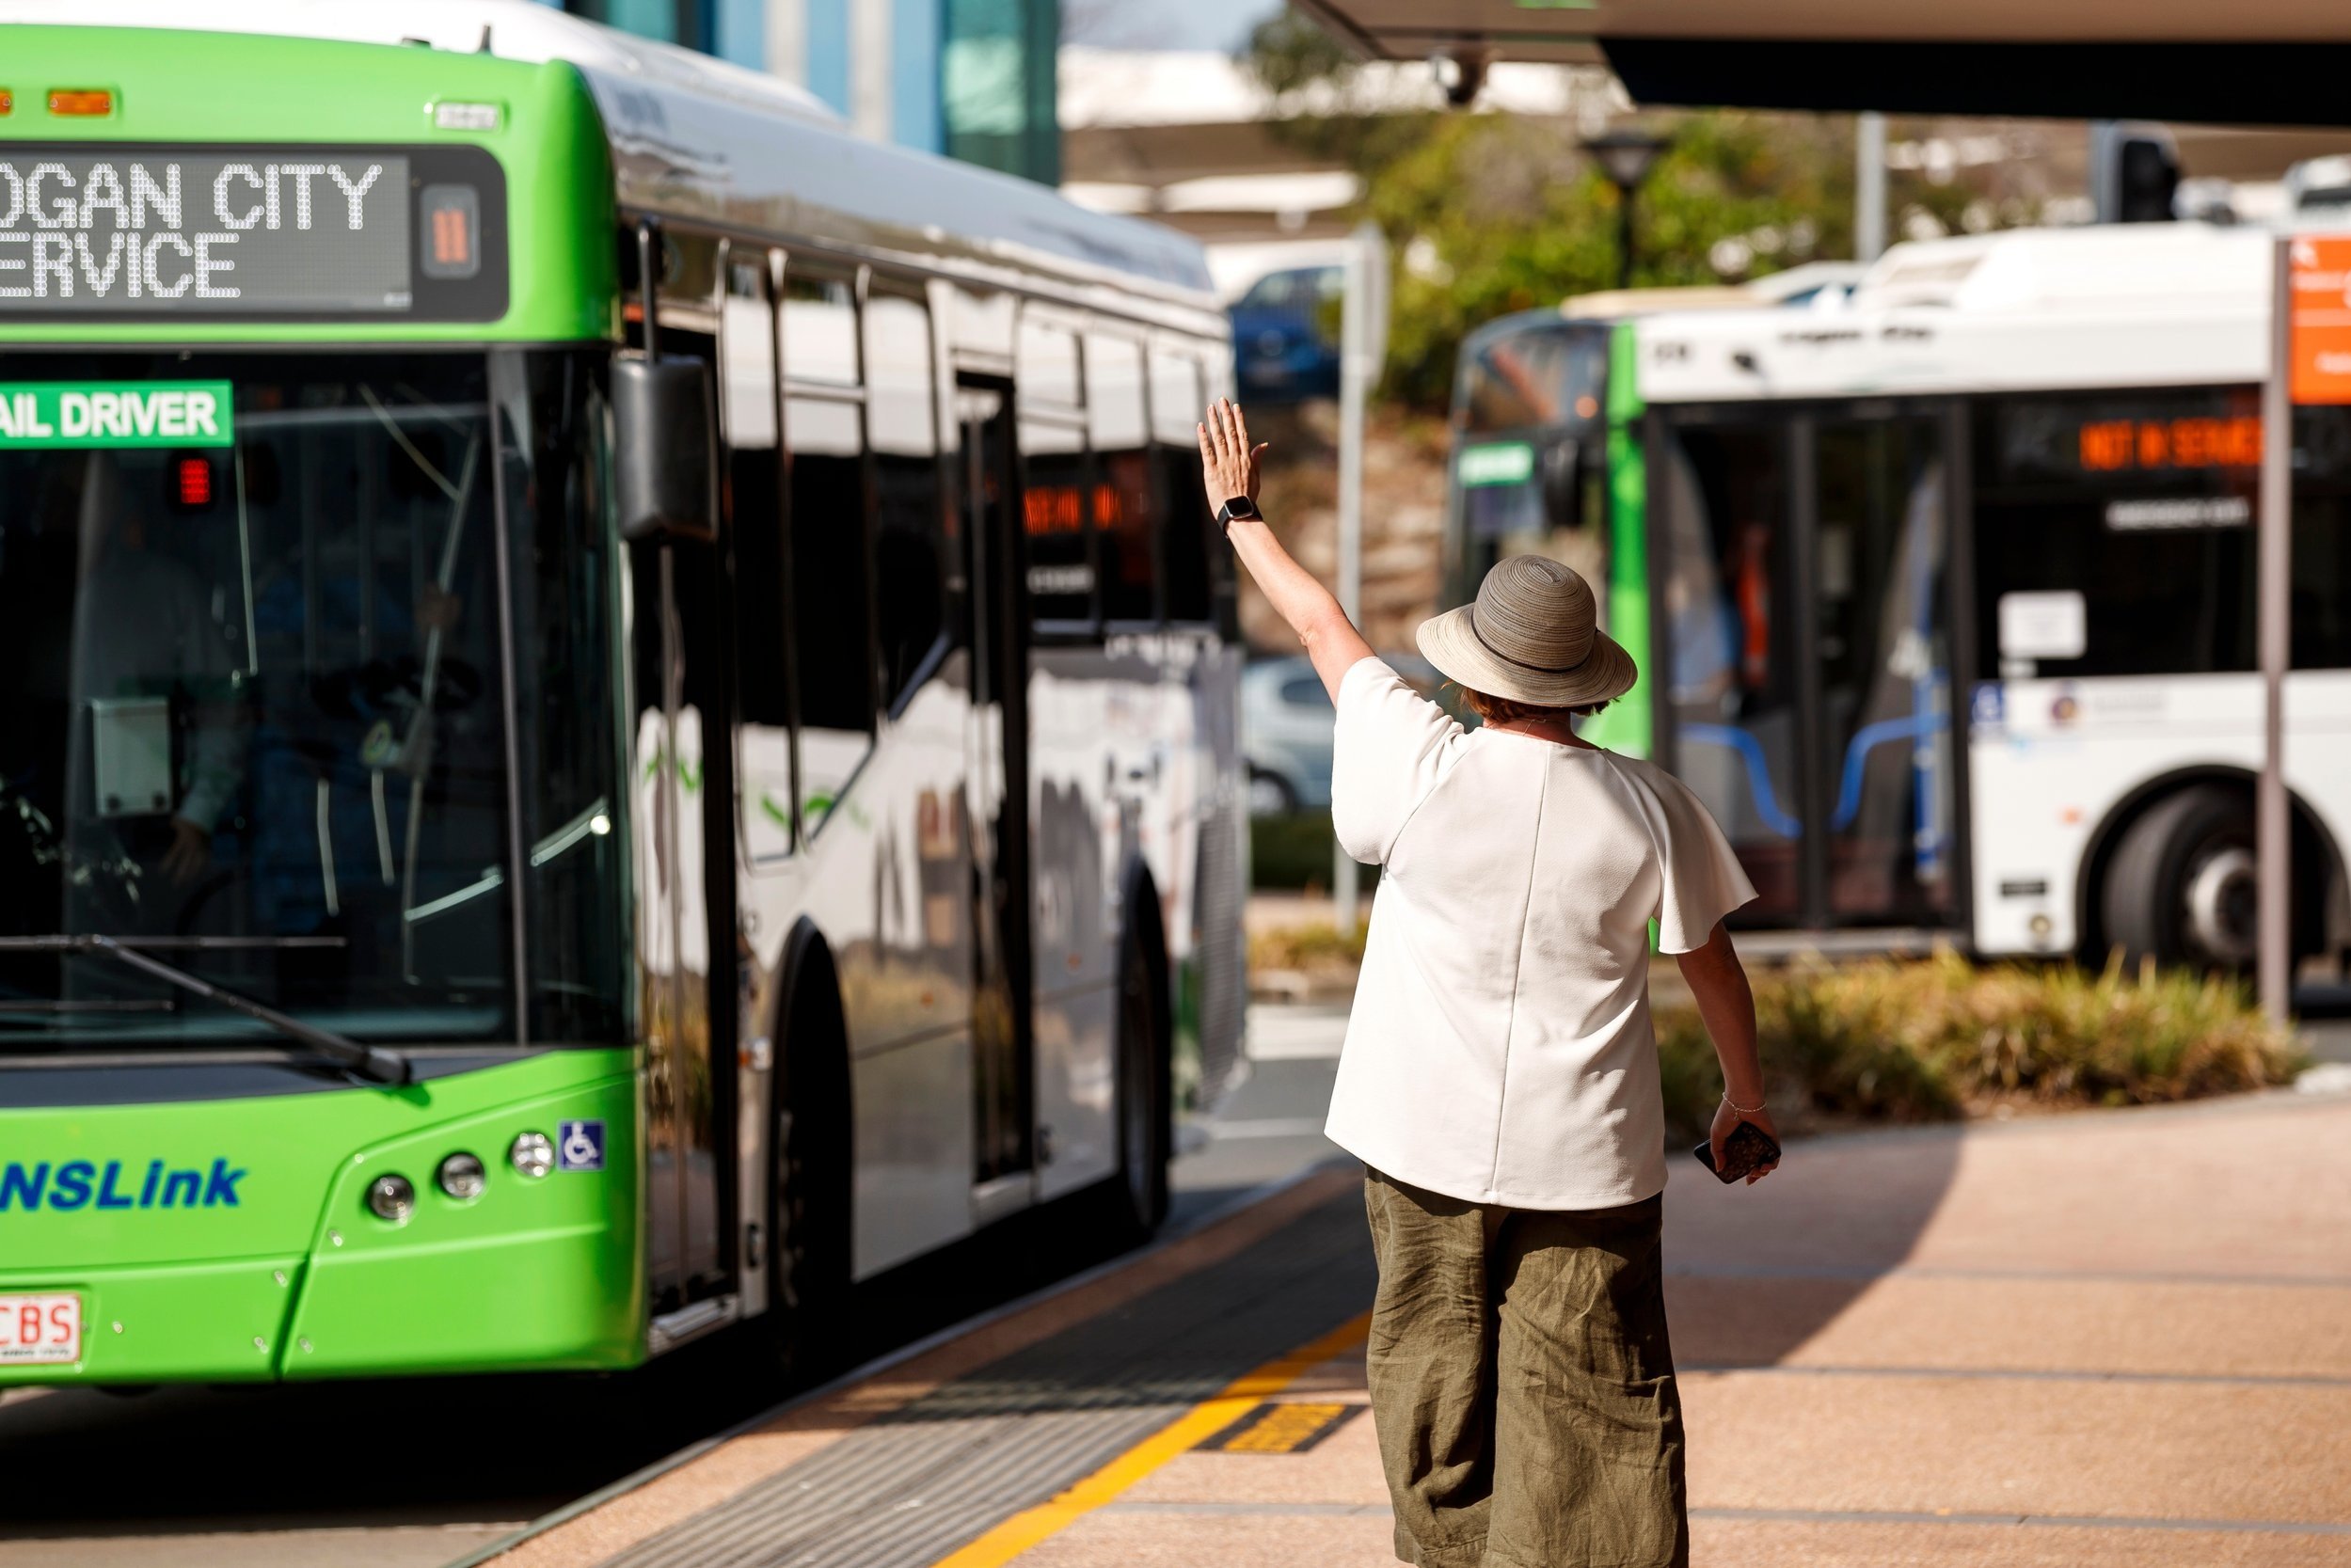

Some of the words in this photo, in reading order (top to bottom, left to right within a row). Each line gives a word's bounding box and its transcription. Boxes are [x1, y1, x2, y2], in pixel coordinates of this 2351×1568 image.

[214, 164, 382, 230] CITY
[0, 232, 241, 298] ERVICE
[59, 390, 219, 437] DRIVER
[0, 1157, 248, 1212] NSLink
